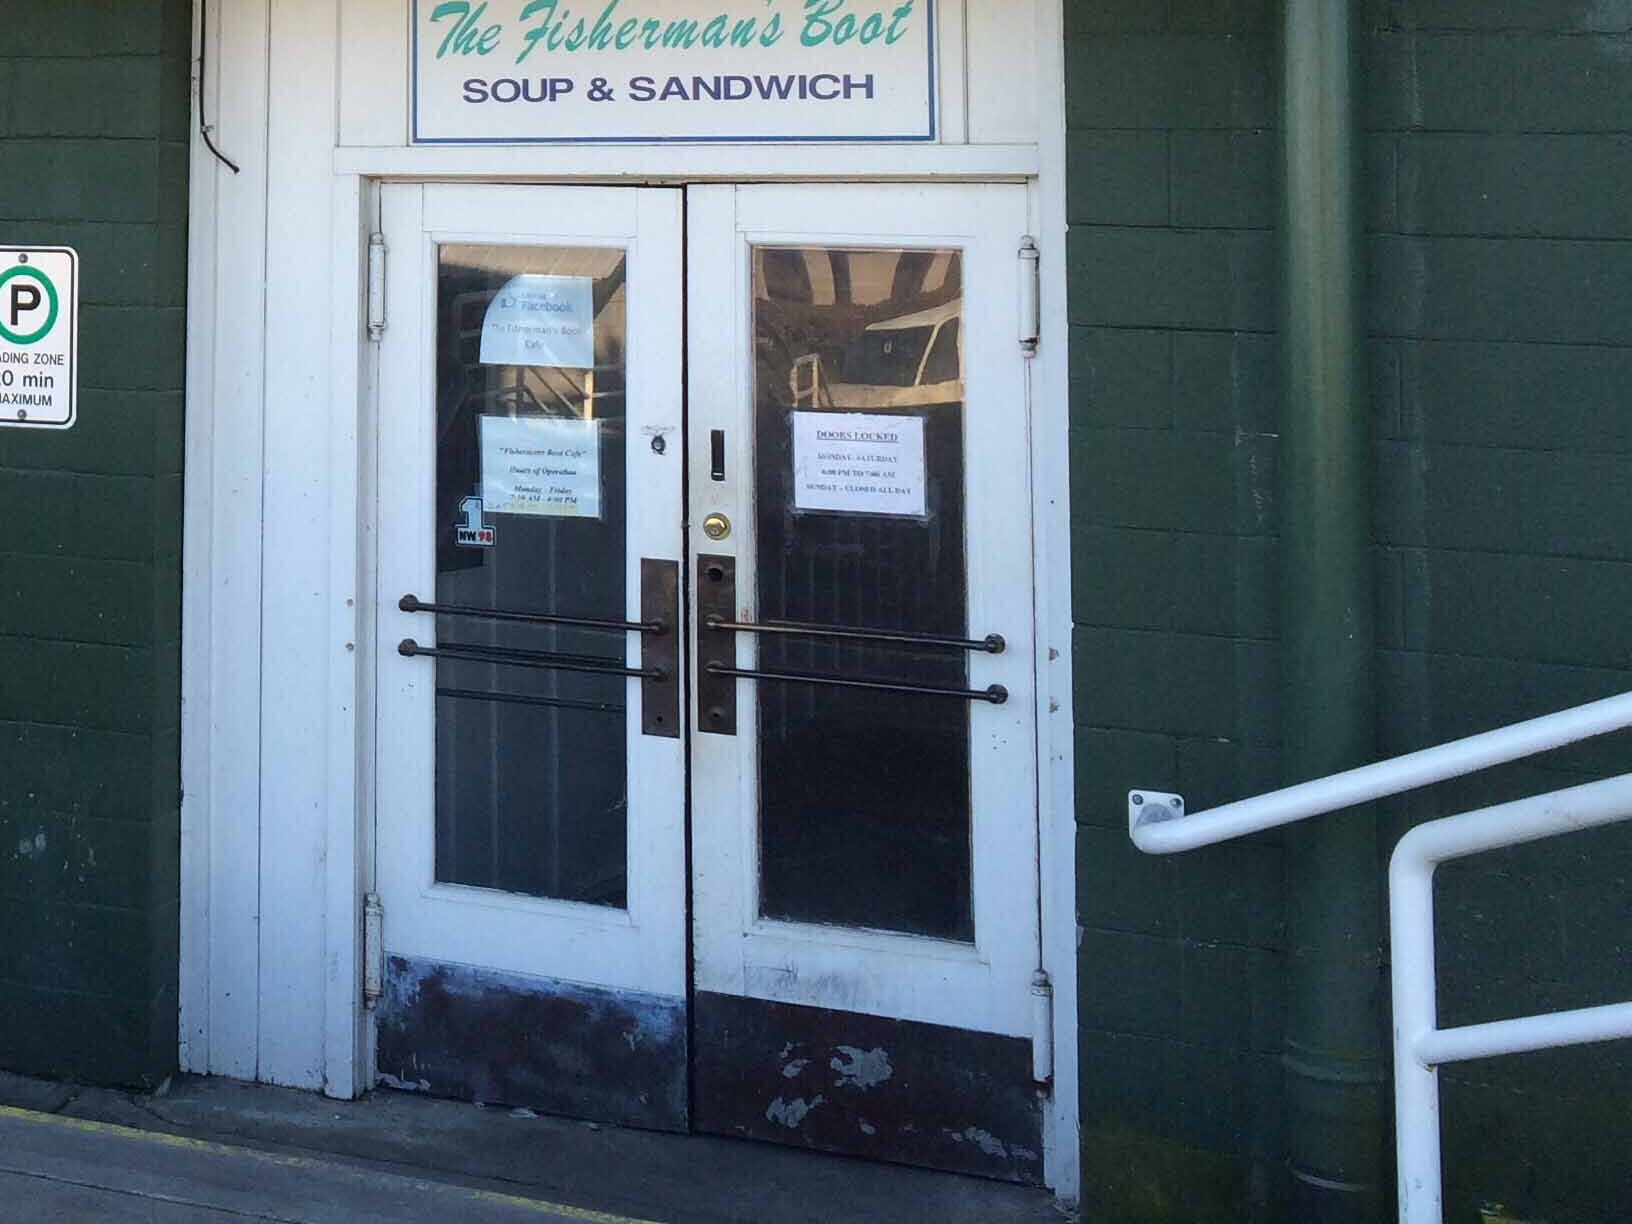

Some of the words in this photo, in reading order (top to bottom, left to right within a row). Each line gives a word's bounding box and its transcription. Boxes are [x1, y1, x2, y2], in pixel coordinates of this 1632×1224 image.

[461, 76, 575, 105] SOUP
[586, 75, 617, 104] &
[628, 73, 876, 103] SANDWICH
[9, 283, 42, 327] P
[33, 352, 65, 366] ZONE
[22, 371, 54, 389] min
[816, 430, 852, 441] DOORS
[854, 431, 899, 442] LOCKED
